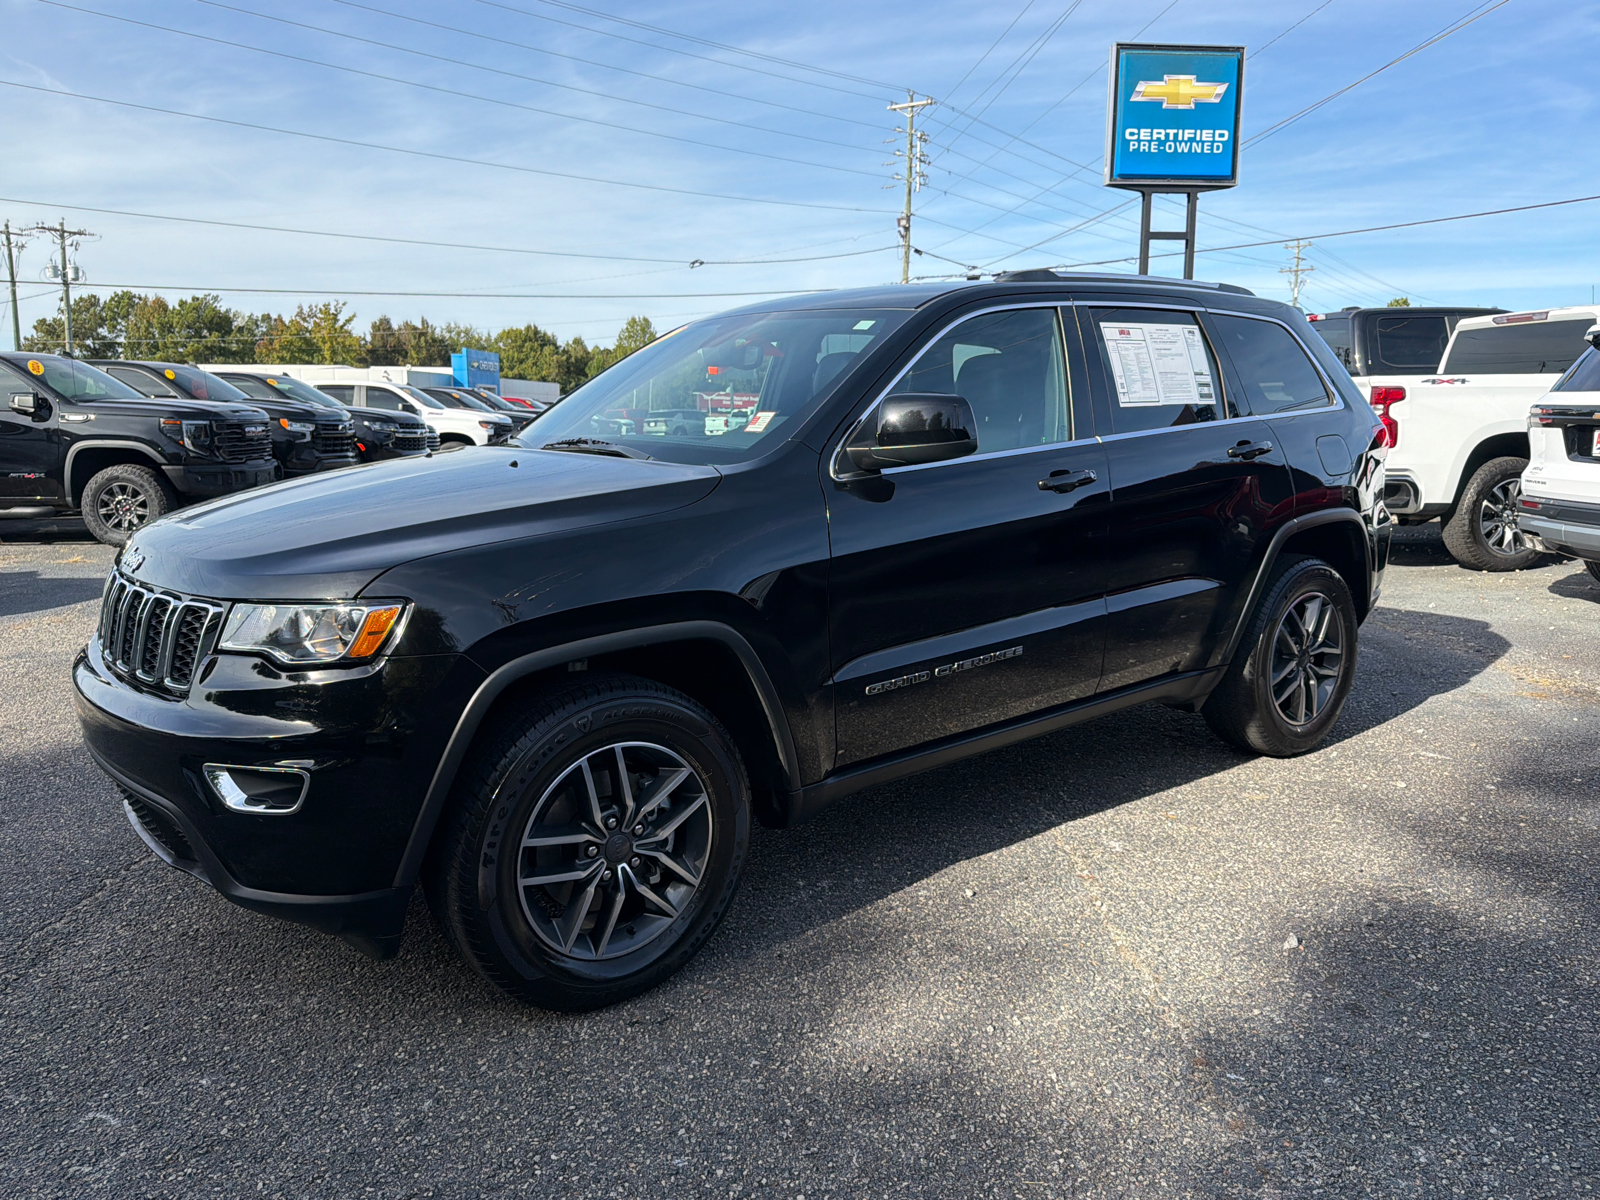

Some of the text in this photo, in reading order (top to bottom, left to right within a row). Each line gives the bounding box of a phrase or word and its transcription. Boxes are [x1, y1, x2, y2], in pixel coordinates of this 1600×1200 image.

[1125, 128, 1229, 141] CERTIFIED
[1129, 141, 1223, 153] PRE-OWNED
[866, 646, 1023, 695] GRAND CHEROKEE
